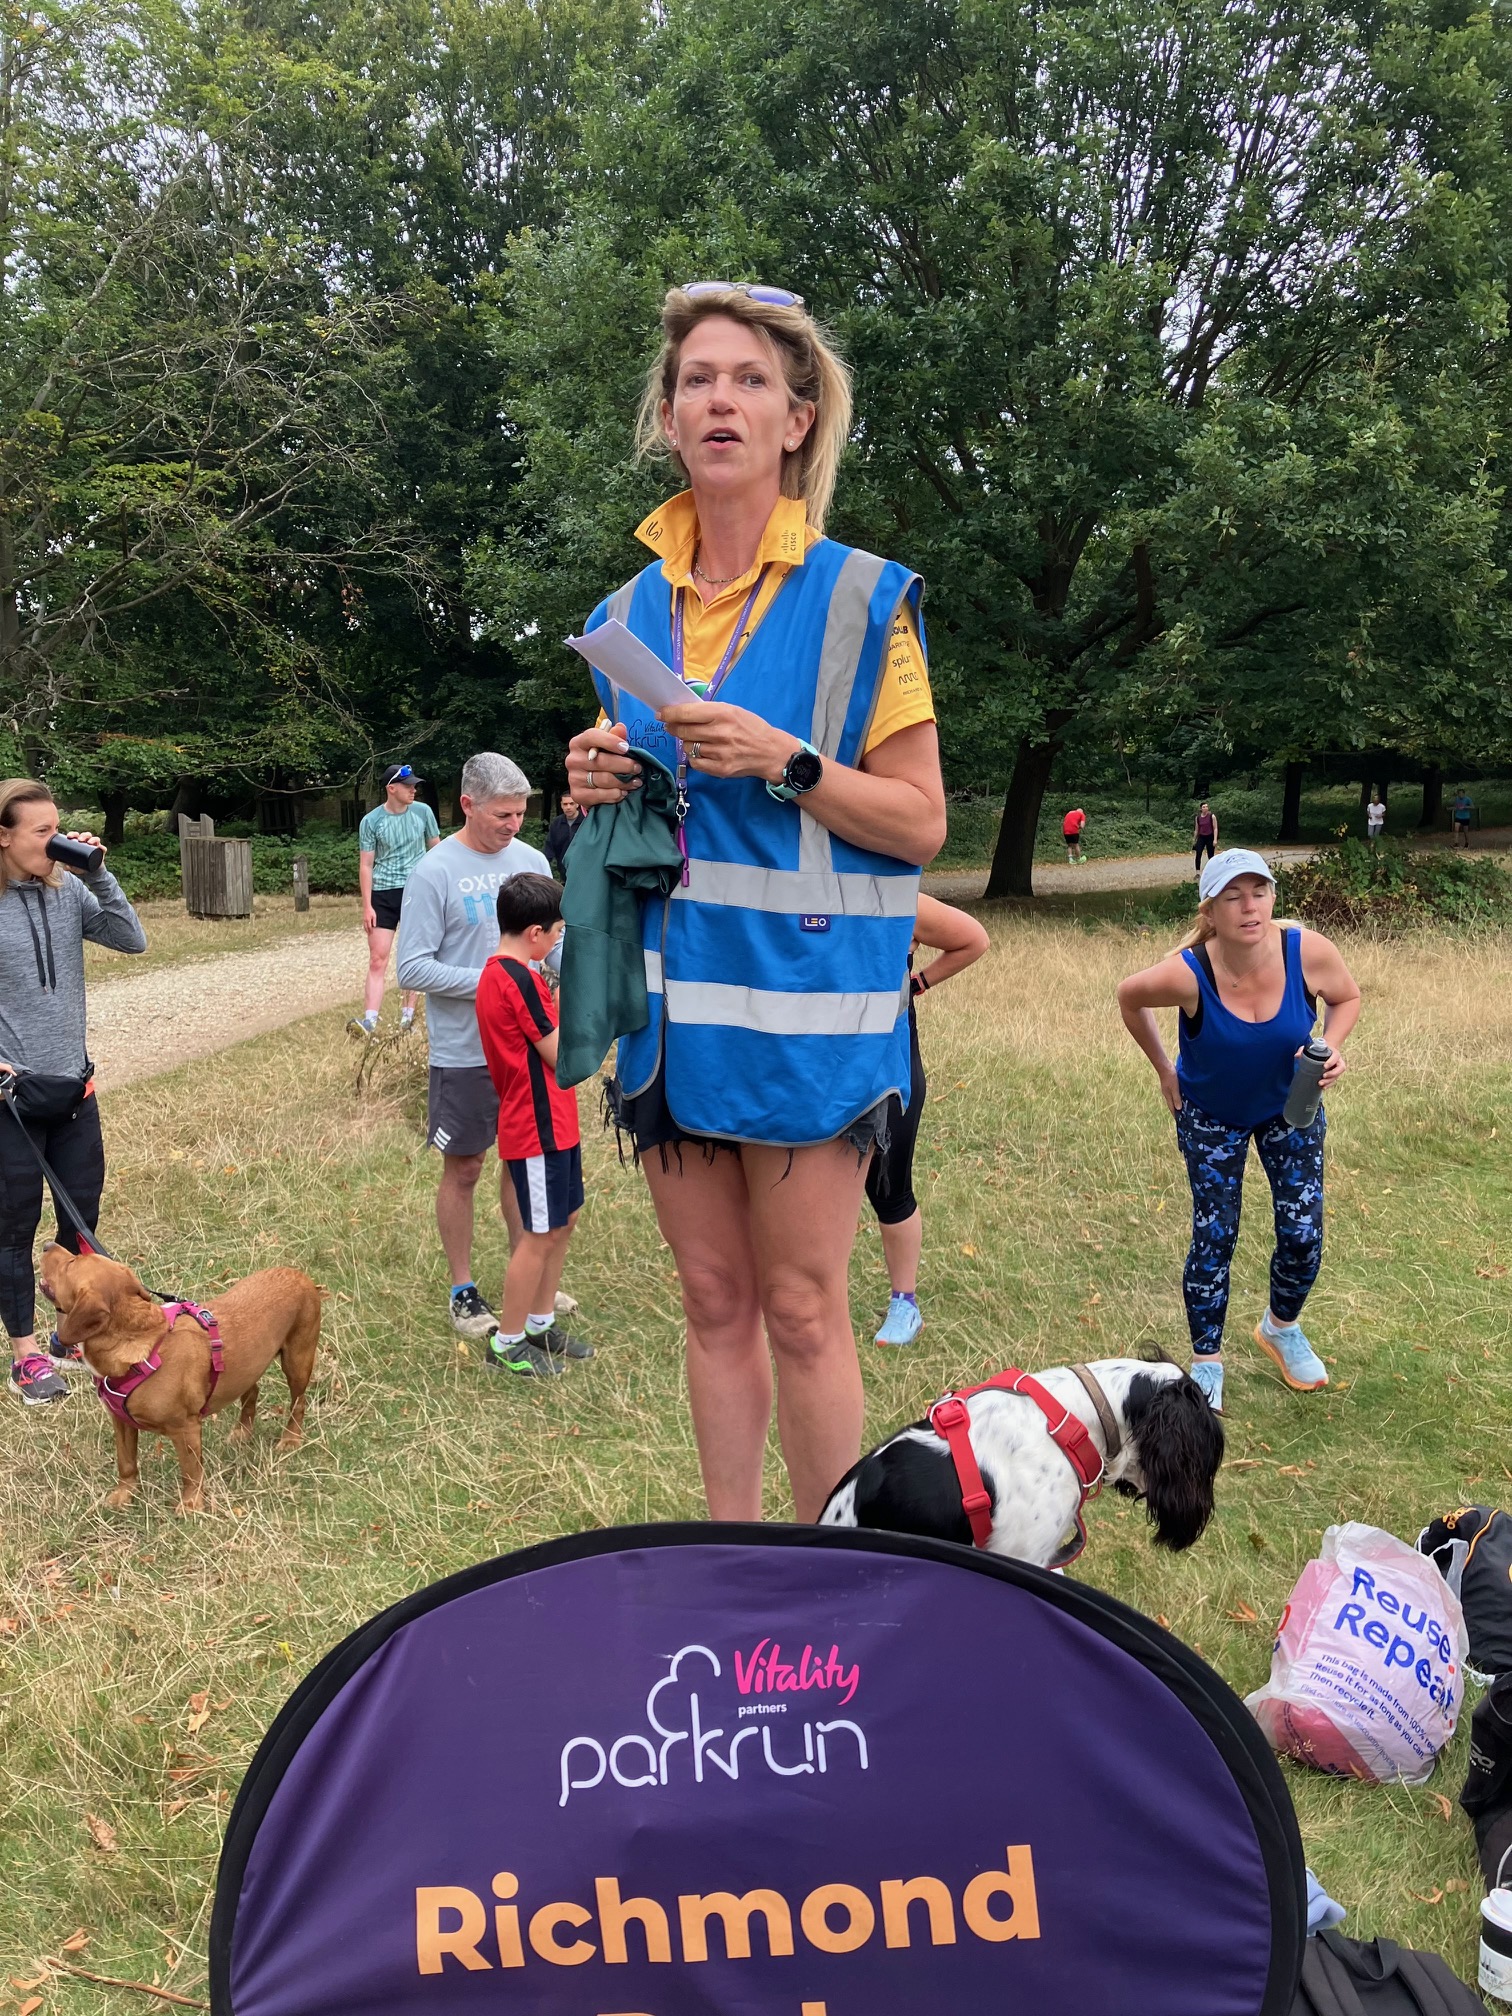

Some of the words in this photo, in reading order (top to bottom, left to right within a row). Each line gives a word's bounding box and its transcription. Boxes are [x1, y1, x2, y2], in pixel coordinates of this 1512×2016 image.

[804, 917, 827, 927] LEO
[734, 1637, 860, 1706] Vitality
[738, 1702, 788, 1719] partners
[1309, 1671, 1333, 1687] Then
[1334, 1684, 1368, 1711] recycle
[1366, 1709, 1375, 1721] it.
[1321, 1654, 1340, 1665] This
[1341, 1661, 1359, 1677] bag
[1360, 1670, 1369, 1681] is
[1369, 1678, 1394, 1702] made
[1392, 1699, 1410, 1721] from
[1409, 1717, 1427, 1741] 100%
[558, 1692, 869, 1807] parkrun
[1315, 1662, 1344, 1679] Reuse
[1345, 1675, 1353, 1686] it
[1353, 1681, 1369, 1696] for
[1369, 1695, 1379, 1706] as
[1379, 1702, 1396, 1724] long
[1394, 1721, 1402, 1731] as
[1401, 1728, 1413, 1745] you
[1413, 1742, 1425, 1760] can.
[415, 1844, 1042, 1975] Richmond
